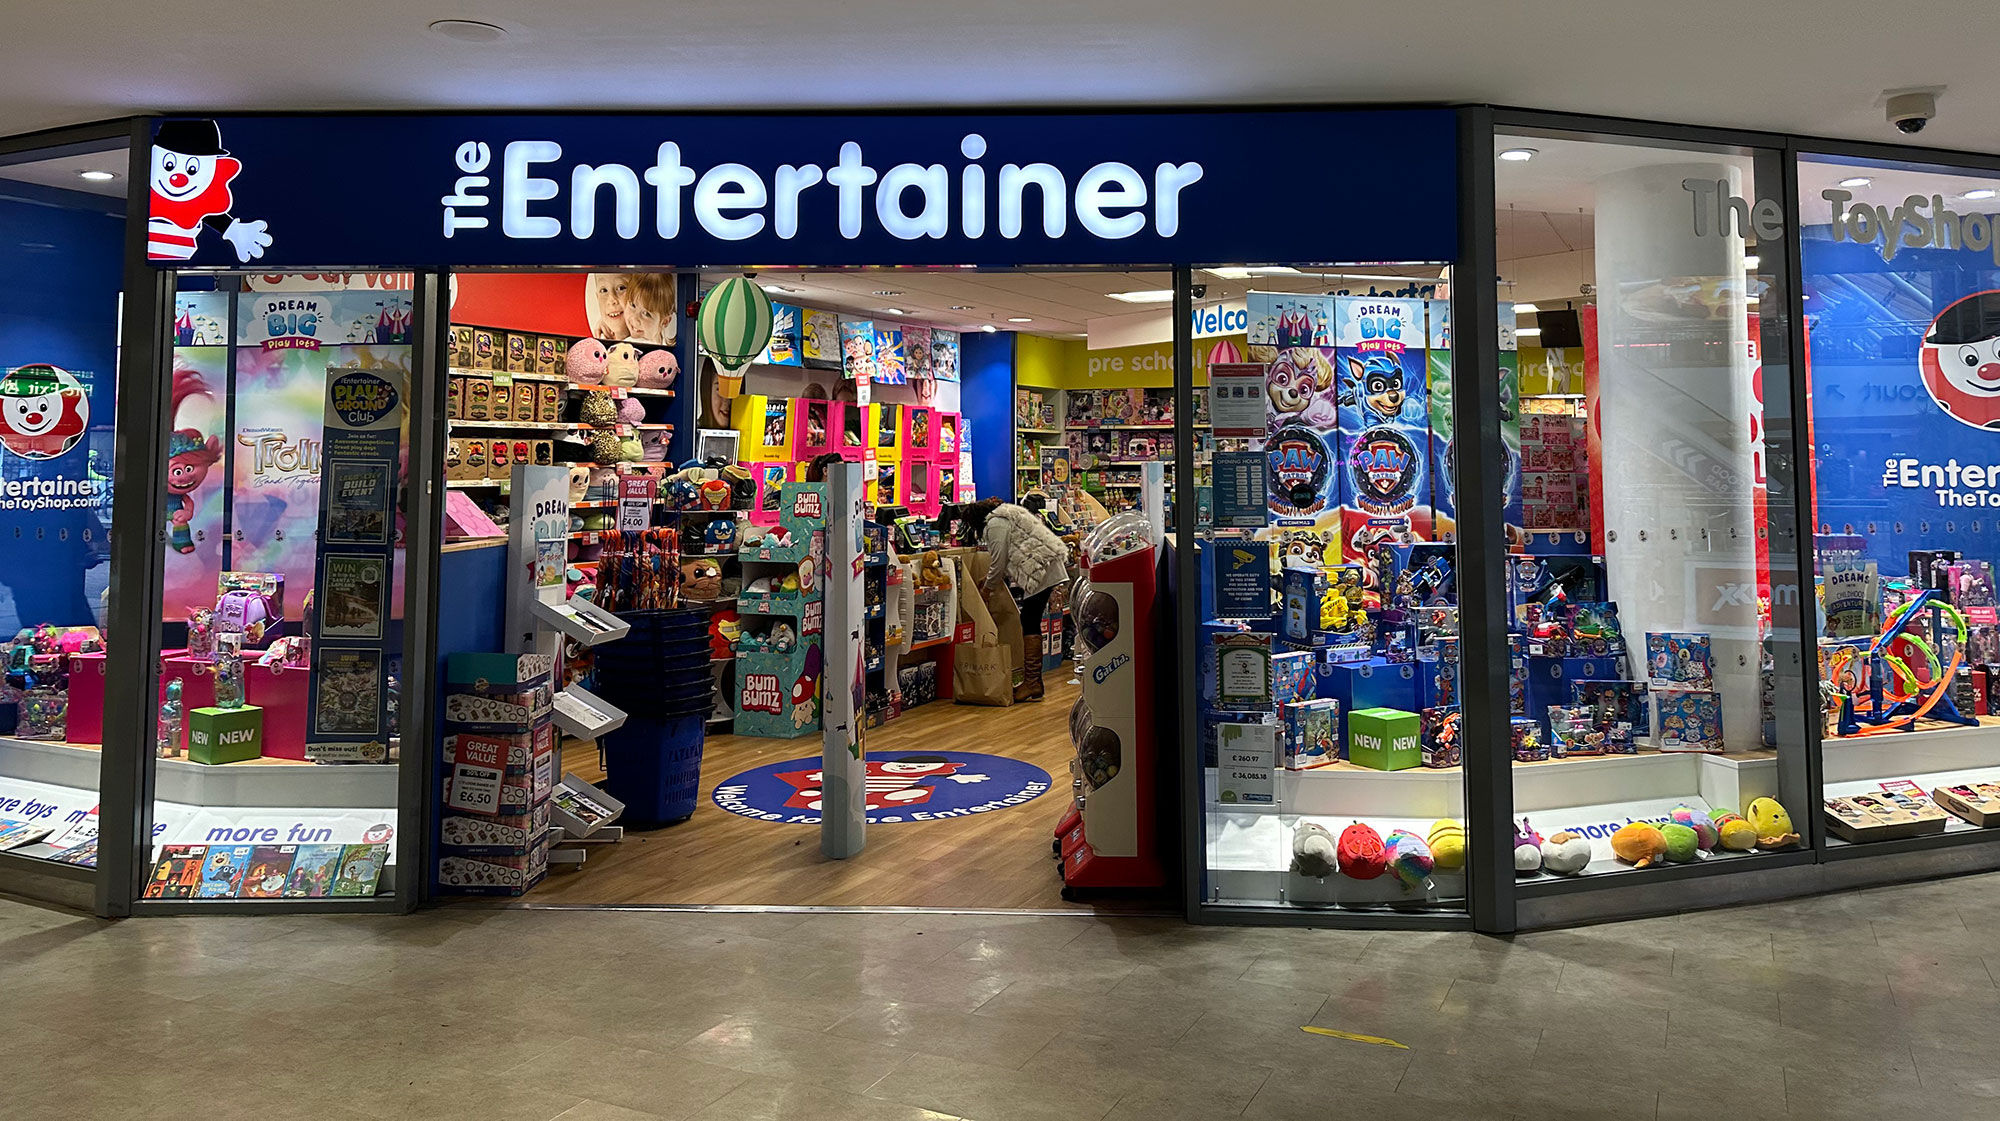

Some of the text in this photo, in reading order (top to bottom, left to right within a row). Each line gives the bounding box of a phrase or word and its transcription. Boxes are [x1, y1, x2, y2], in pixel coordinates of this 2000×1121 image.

[441, 133, 1204, 240] The Entertainer
[1682, 178, 2000, 267] The ToySho
[268, 300, 318, 312] DREAM
[1360, 304, 1401, 317] DREAM
[267, 314, 319, 337] BIG
[1360, 317, 1402, 340] BIG
[268, 338, 315, 349] Play lots
[1361, 341, 1401, 351] Play lots
[1088, 355, 1124, 377] pre
[334, 385, 379, 401] PLAY
[335, 399, 387, 412] GROUND
[348, 411, 375, 423] Club
[238, 433, 322, 475] Troll
[1267, 448, 1323, 473] PAW
[1357, 448, 1412, 473] PAW
[1882, 458, 1899, 487] The
[343, 479, 376, 489] BUILD
[342, 487, 374, 498] EVENT
[797, 493, 818, 503] BUM
[535, 499, 567, 518] DREAM
[794, 503, 820, 514] BUMZ
[1357, 498, 1415, 517] MIGHTY MOVIE
[332, 563, 356, 573] WIN
[1832, 573, 1870, 585] DREAMS
[1836, 591, 1865, 600] CHILDHOOD
[804, 602, 822, 617] BUM
[802, 615, 822, 632] BUMZ
[959, 662, 998, 672] PRIMARK
[1093, 653, 1130, 684] Gacha.
[746, 675, 776, 691] BUM
[743, 690, 780, 707] BUMZ
[192, 728, 255, 746] NEW NEW
[1354, 733, 1417, 752] NEW NEW
[467, 741, 499, 754] GREAT
[466, 751, 497, 764] VALUE
[459, 791, 491, 804] £6.50
[715, 784, 783, 823] Welcome
[911, 781, 1048, 822] Entertainer
[18, 798, 59, 822] toys
[205, 823, 333, 843] more fun
